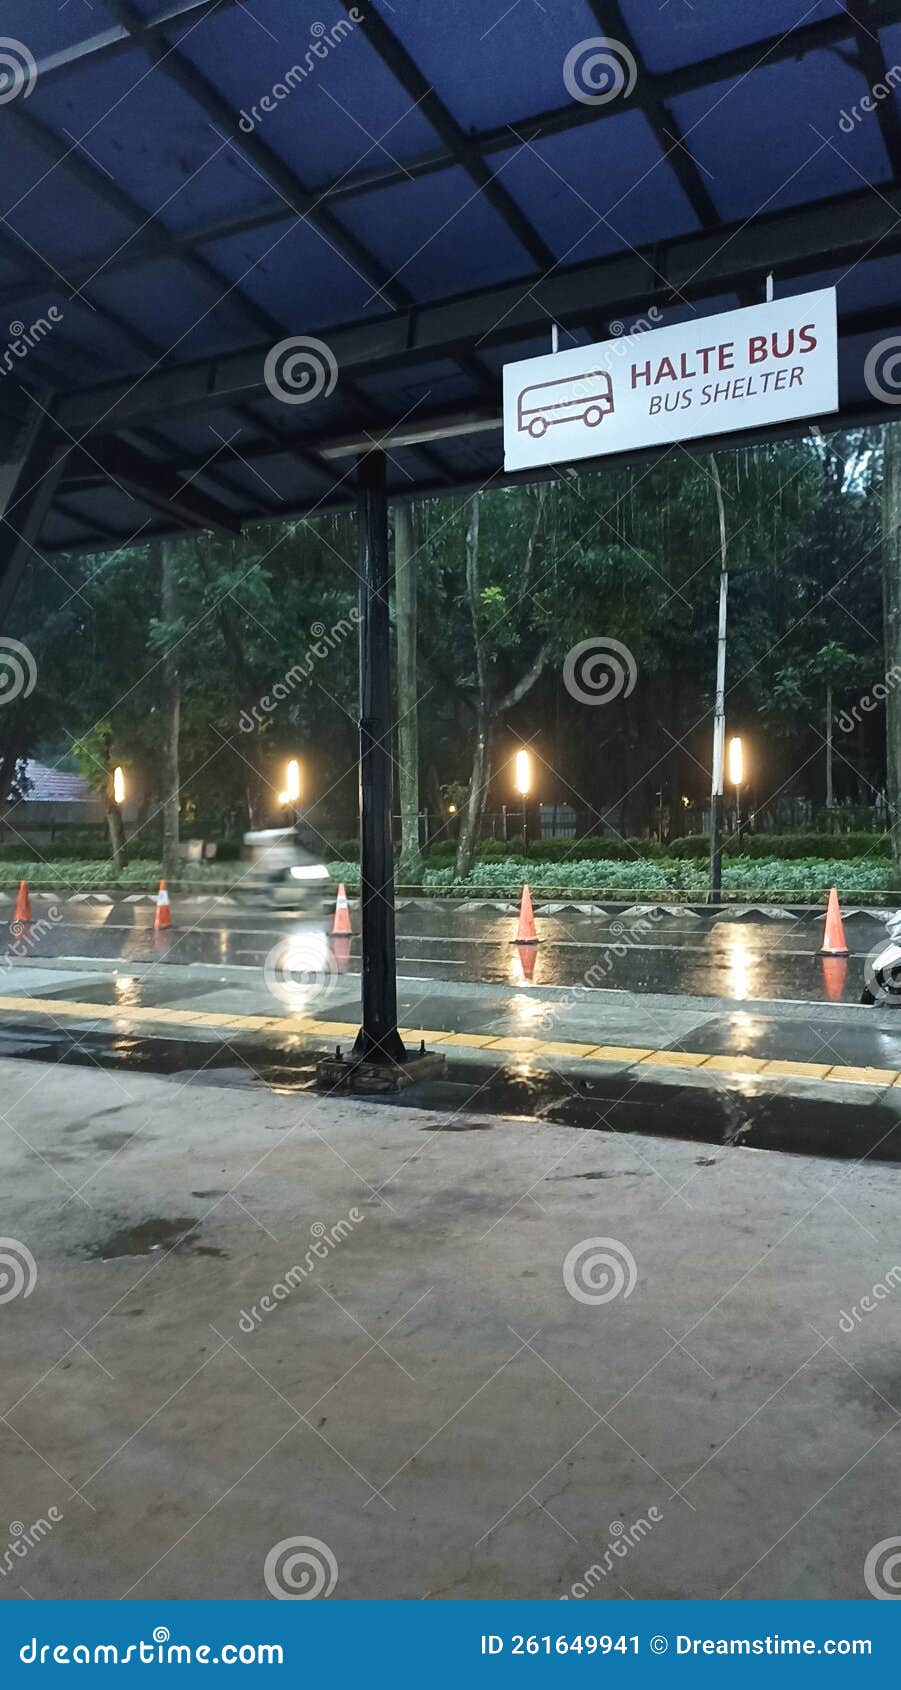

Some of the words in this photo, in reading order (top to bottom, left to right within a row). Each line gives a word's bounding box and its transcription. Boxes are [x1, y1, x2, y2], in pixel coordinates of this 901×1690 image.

[631, 342, 734, 389] HALTE
[748, 324, 817, 364] BUS
[649, 388, 692, 416] BUS
[700, 366, 804, 405] SHELTER
